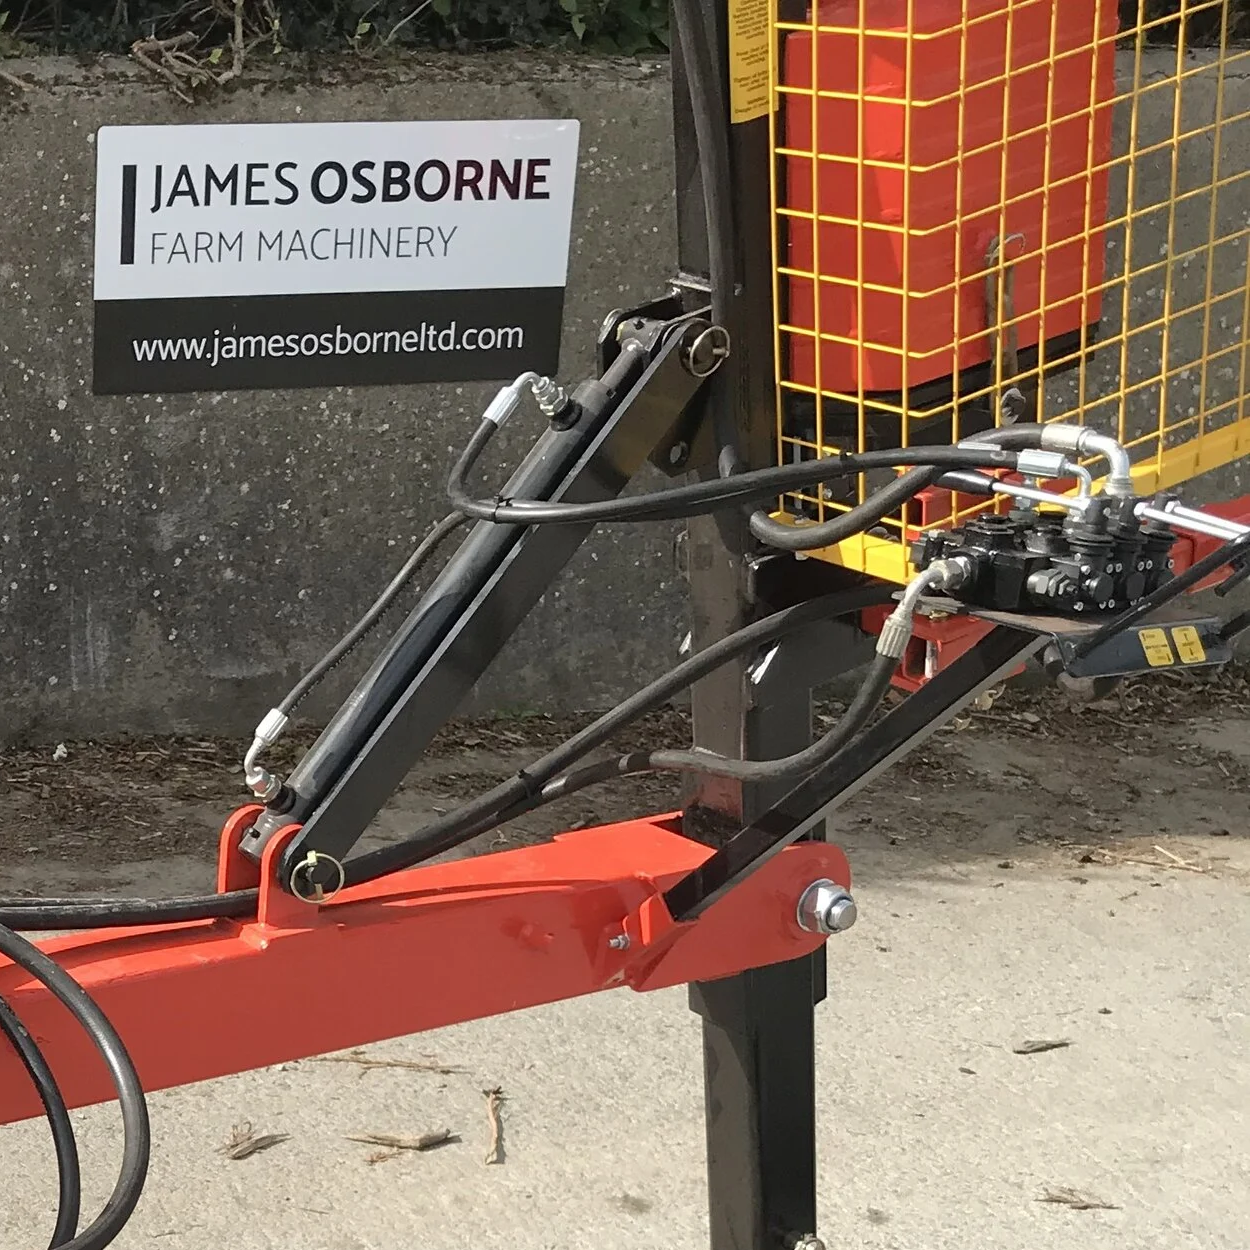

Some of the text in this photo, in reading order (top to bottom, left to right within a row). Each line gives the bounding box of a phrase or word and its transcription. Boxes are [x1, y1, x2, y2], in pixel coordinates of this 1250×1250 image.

[150, 158, 551, 213] JAMES OSBORNE
[150, 226, 458, 265] FARM MACHINERY
[132, 322, 524, 367] www.jamesosborneltd.com
